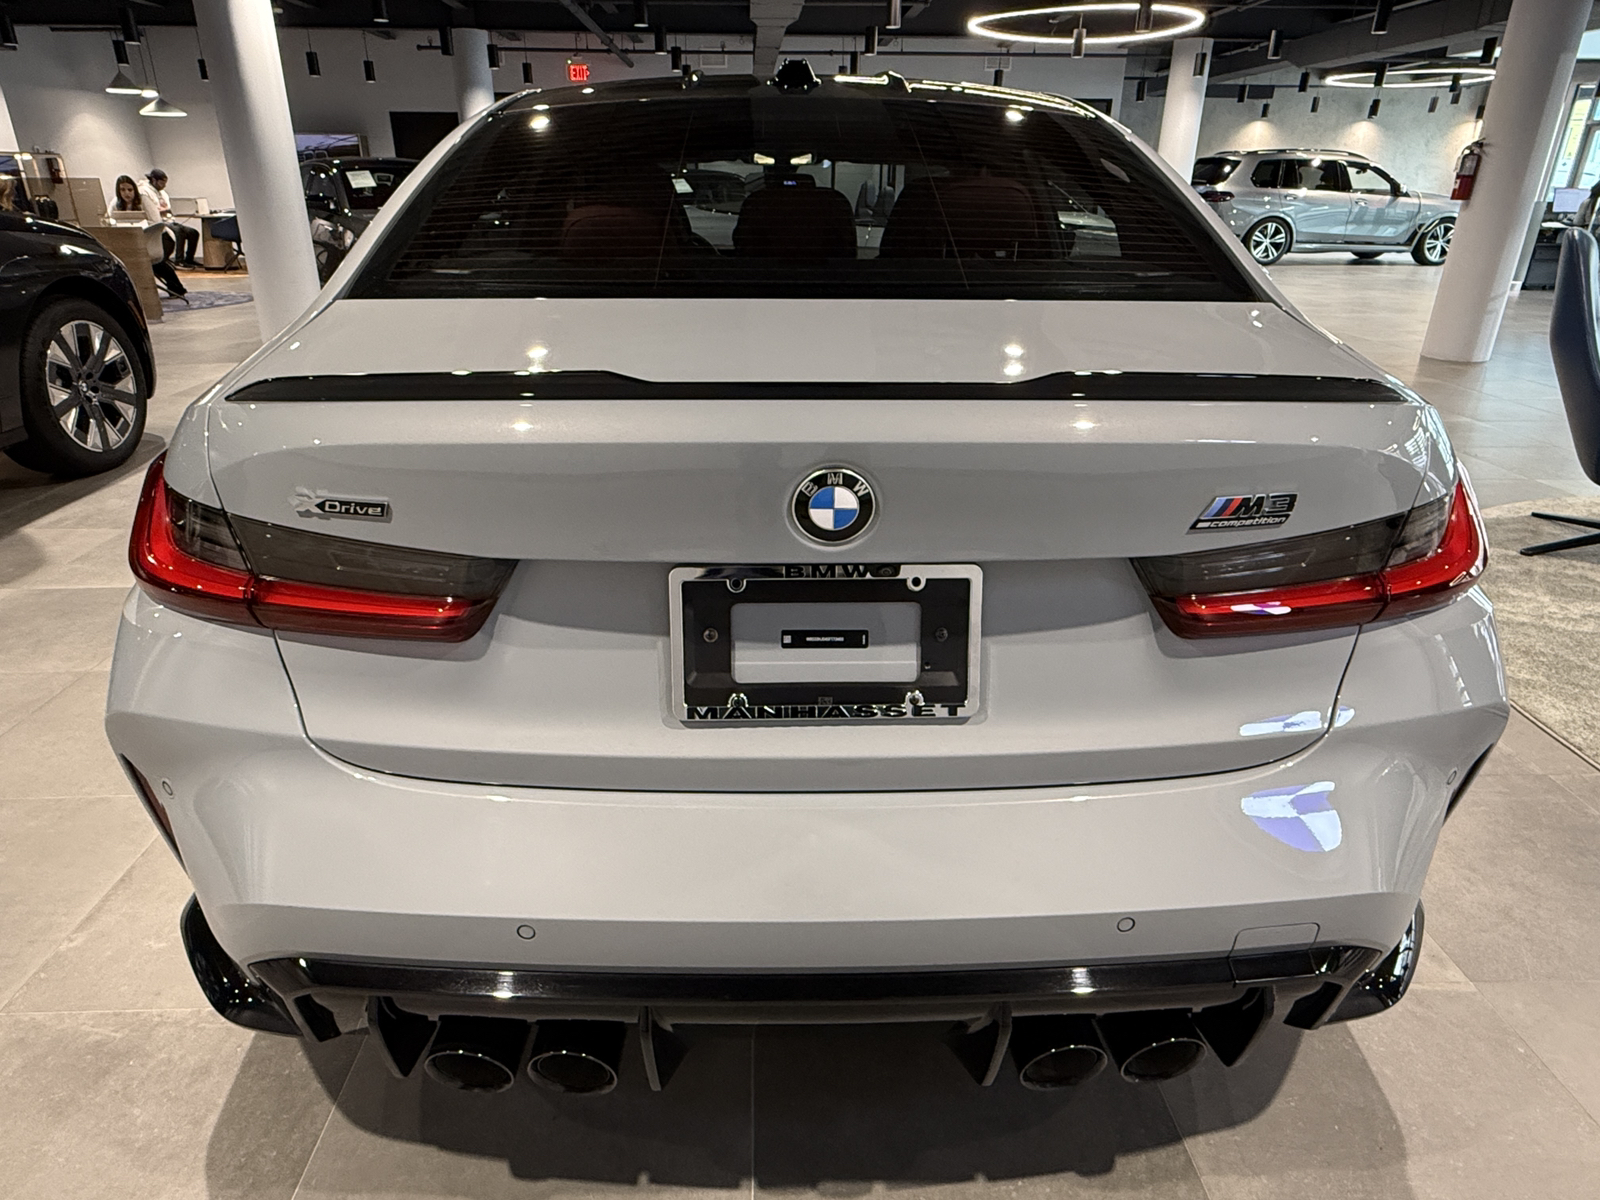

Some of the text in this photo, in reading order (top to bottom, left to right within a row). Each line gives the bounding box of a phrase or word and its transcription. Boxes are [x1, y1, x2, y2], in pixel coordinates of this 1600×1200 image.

[570, 65, 587, 81] EXIT
[801, 472, 870, 497] BMW
[1229, 493, 1299, 517] M3
[1209, 516, 1287, 528] competition
[784, 564, 868, 578] BMW
[687, 704, 966, 719] MANHASSET
